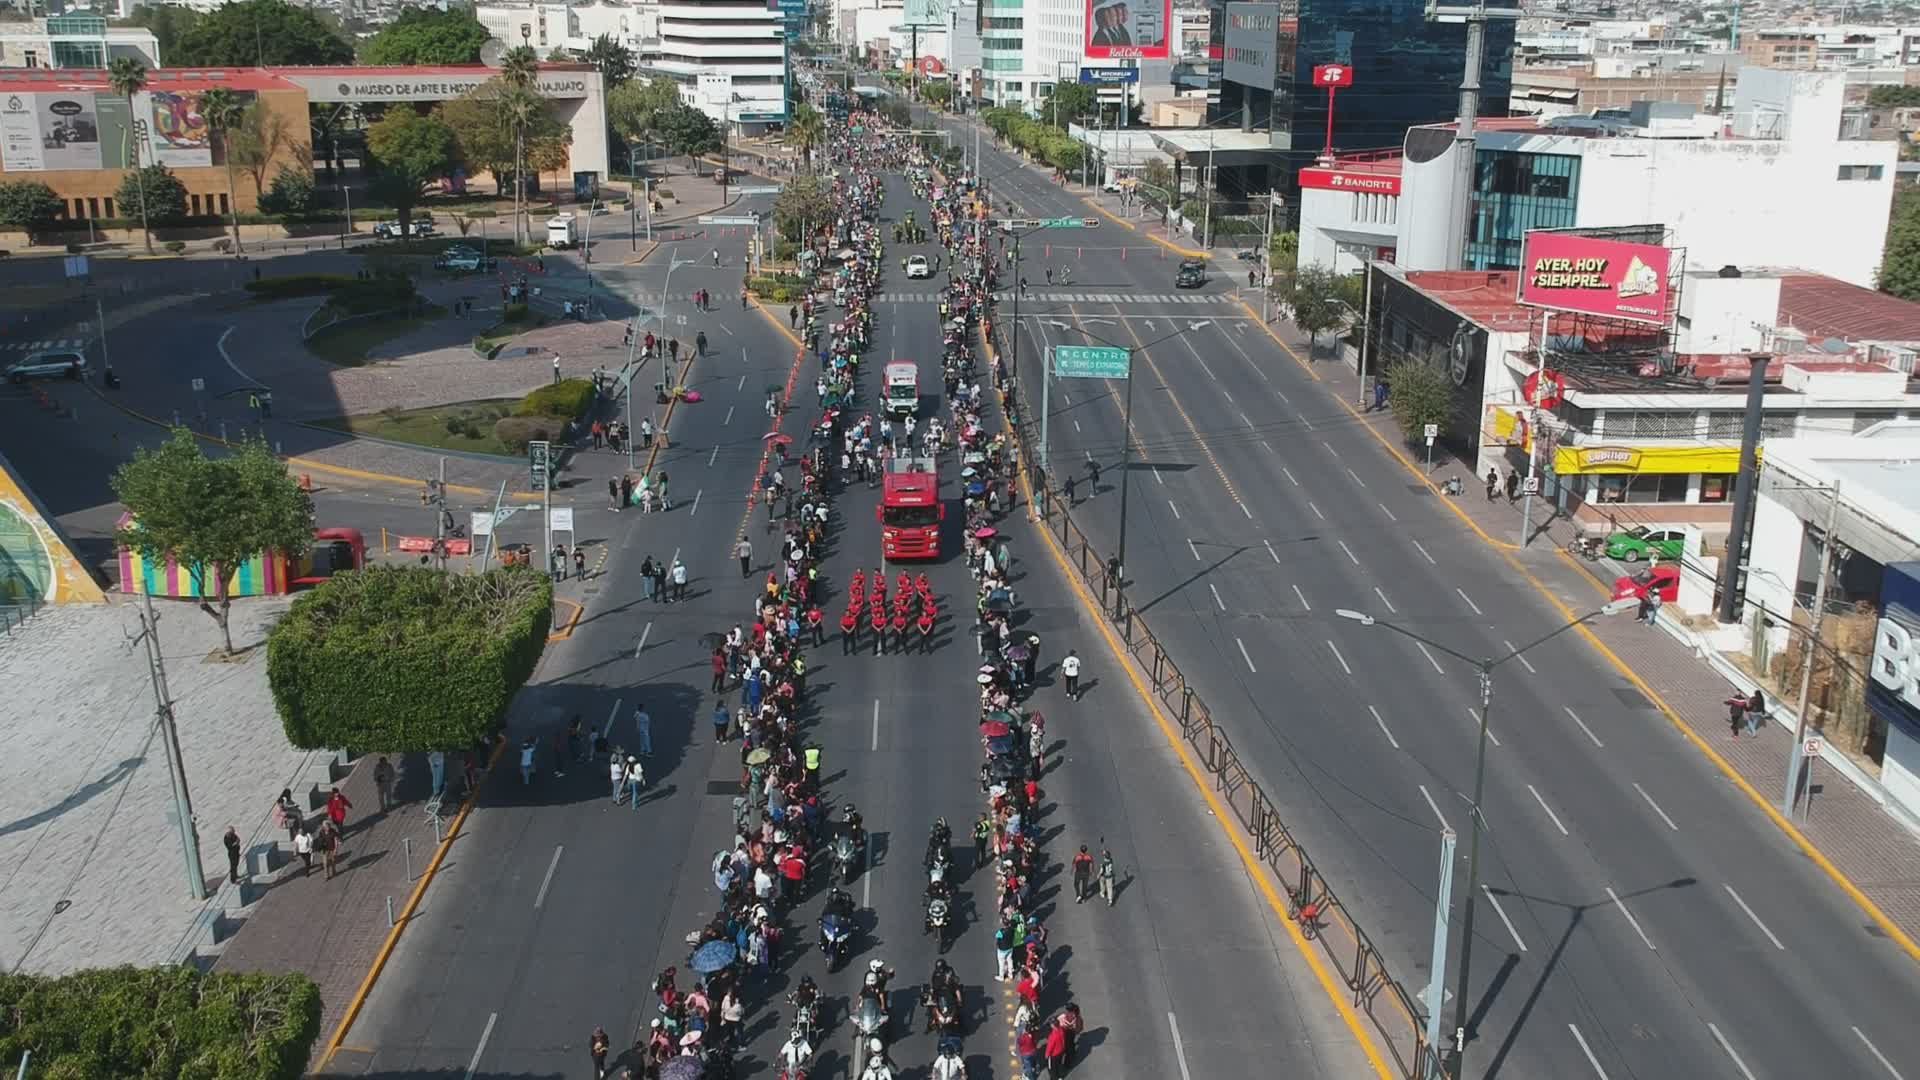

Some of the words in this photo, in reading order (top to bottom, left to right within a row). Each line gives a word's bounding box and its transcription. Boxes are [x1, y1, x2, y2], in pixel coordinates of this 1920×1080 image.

[355, 84, 394, 95] MUSEO
[396, 84, 411, 94] DE
[413, 83, 439, 94] ARTE
[440, 83, 448, 93] E
[1344, 178, 1392, 189] BANORTE
[1535, 258, 1573, 272] AYER,
[1575, 258, 1607, 271] HOY
[1538, 274, 1611, 288] SIEMPRE...
[1073, 350, 1128, 359] CENTRO
